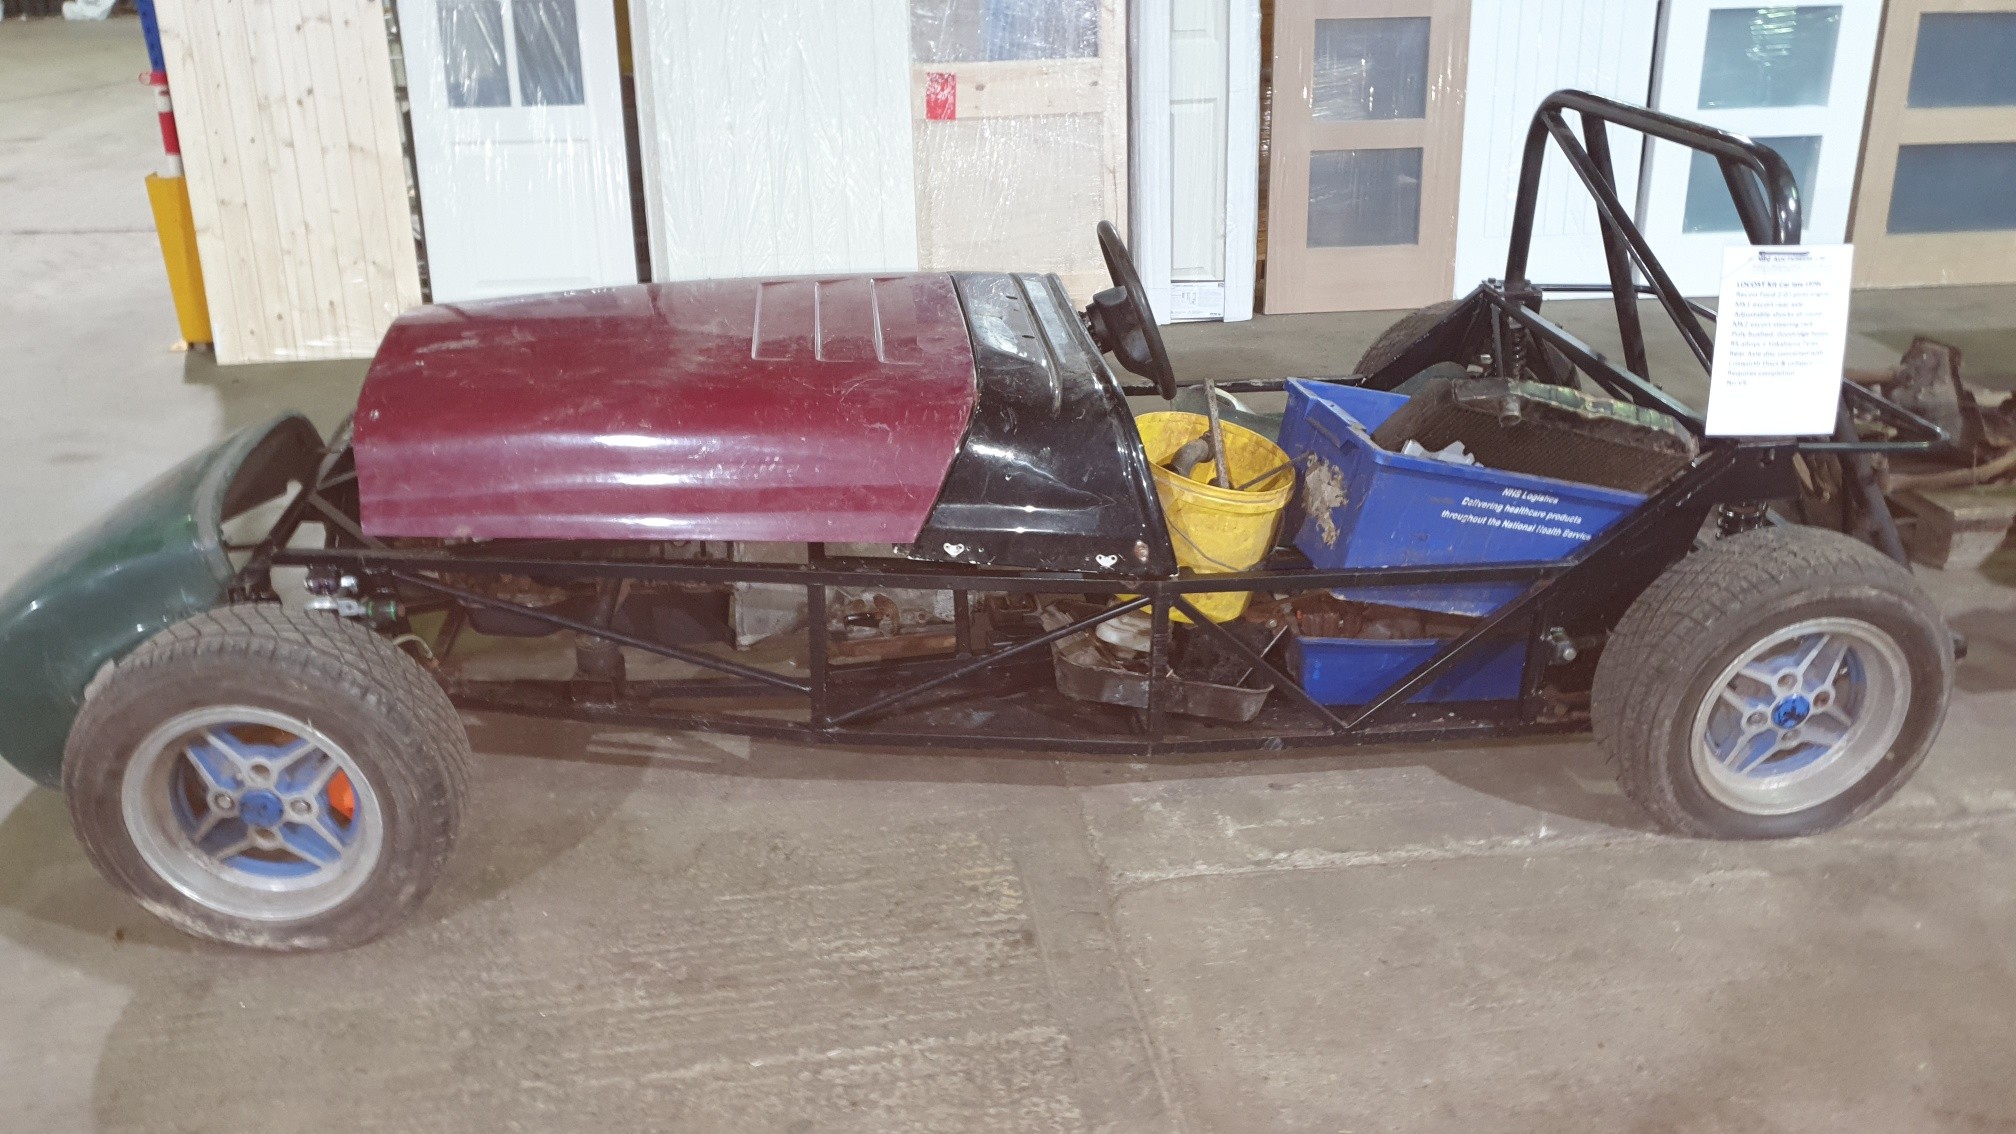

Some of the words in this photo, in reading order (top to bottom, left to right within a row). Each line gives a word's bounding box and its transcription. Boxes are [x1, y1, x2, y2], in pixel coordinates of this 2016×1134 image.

[1502, 488, 1521, 498] NHS
[1522, 490, 1559, 504] Logistics
[1461, 497, 1503, 513] Delivering
[1504, 504, 1546, 518] healthcare
[1546, 512, 1581, 524] products
[1441, 510, 1486, 523] throughout
[1488, 516, 1501, 527] the
[1502, 519, 1535, 532] National
[1536, 524, 1561, 536] Health
[1562, 529, 1592, 541] Service
